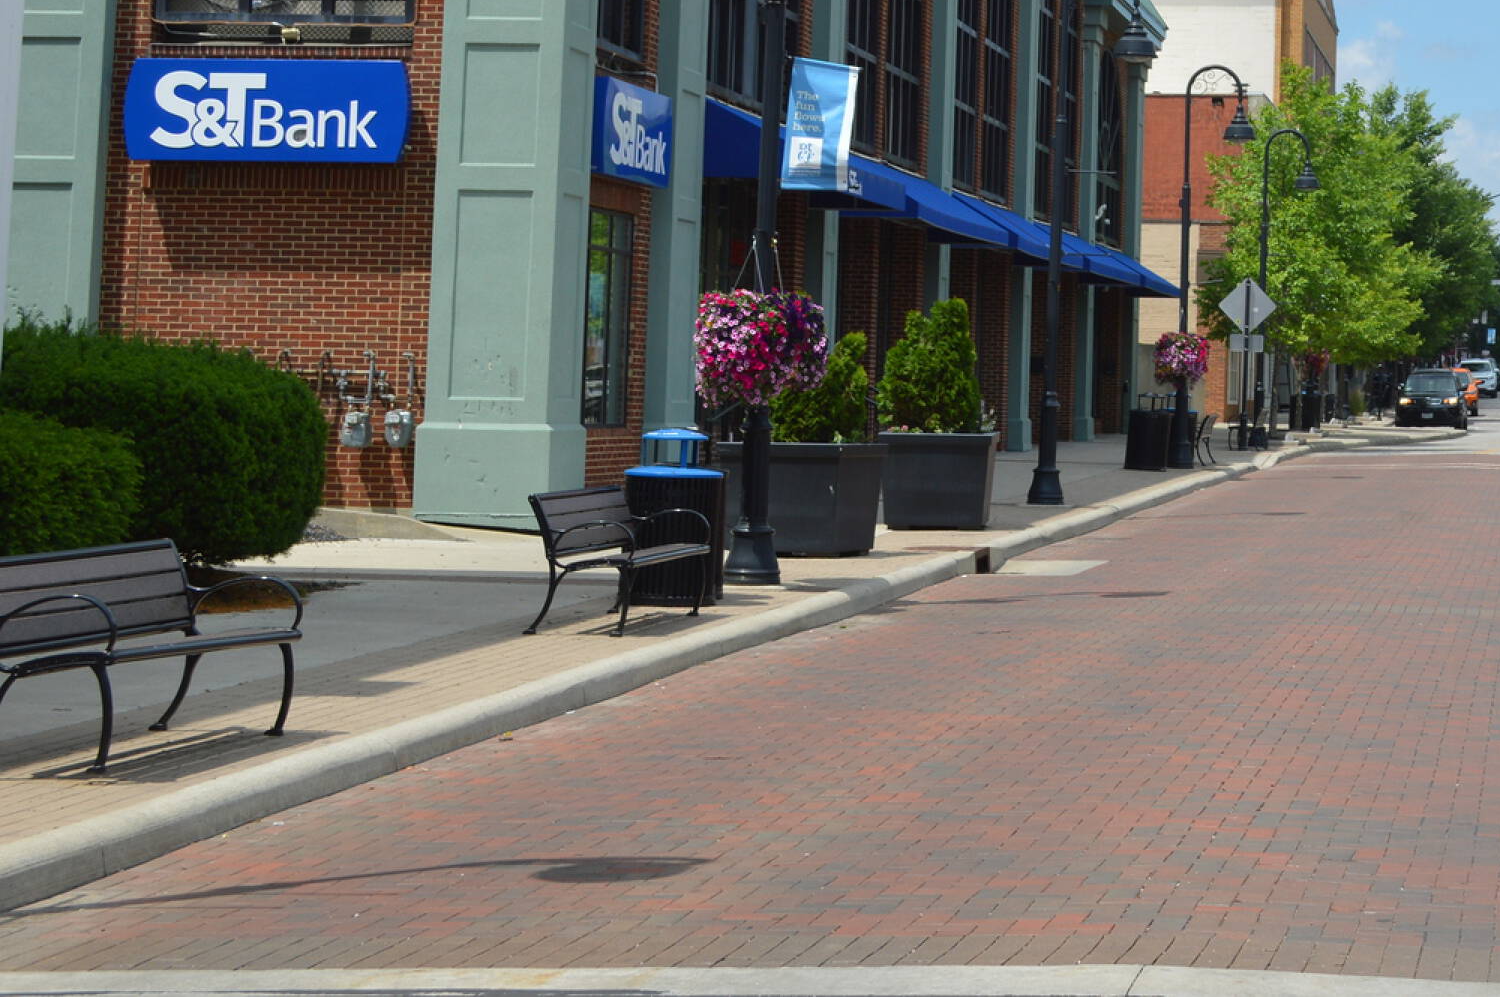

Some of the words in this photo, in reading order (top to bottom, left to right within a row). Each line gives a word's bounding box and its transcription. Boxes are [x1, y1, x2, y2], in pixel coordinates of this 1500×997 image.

[150, 70, 267, 149] S&T
[251, 99, 378, 149] Bank
[635, 124, 667, 176] Bank
